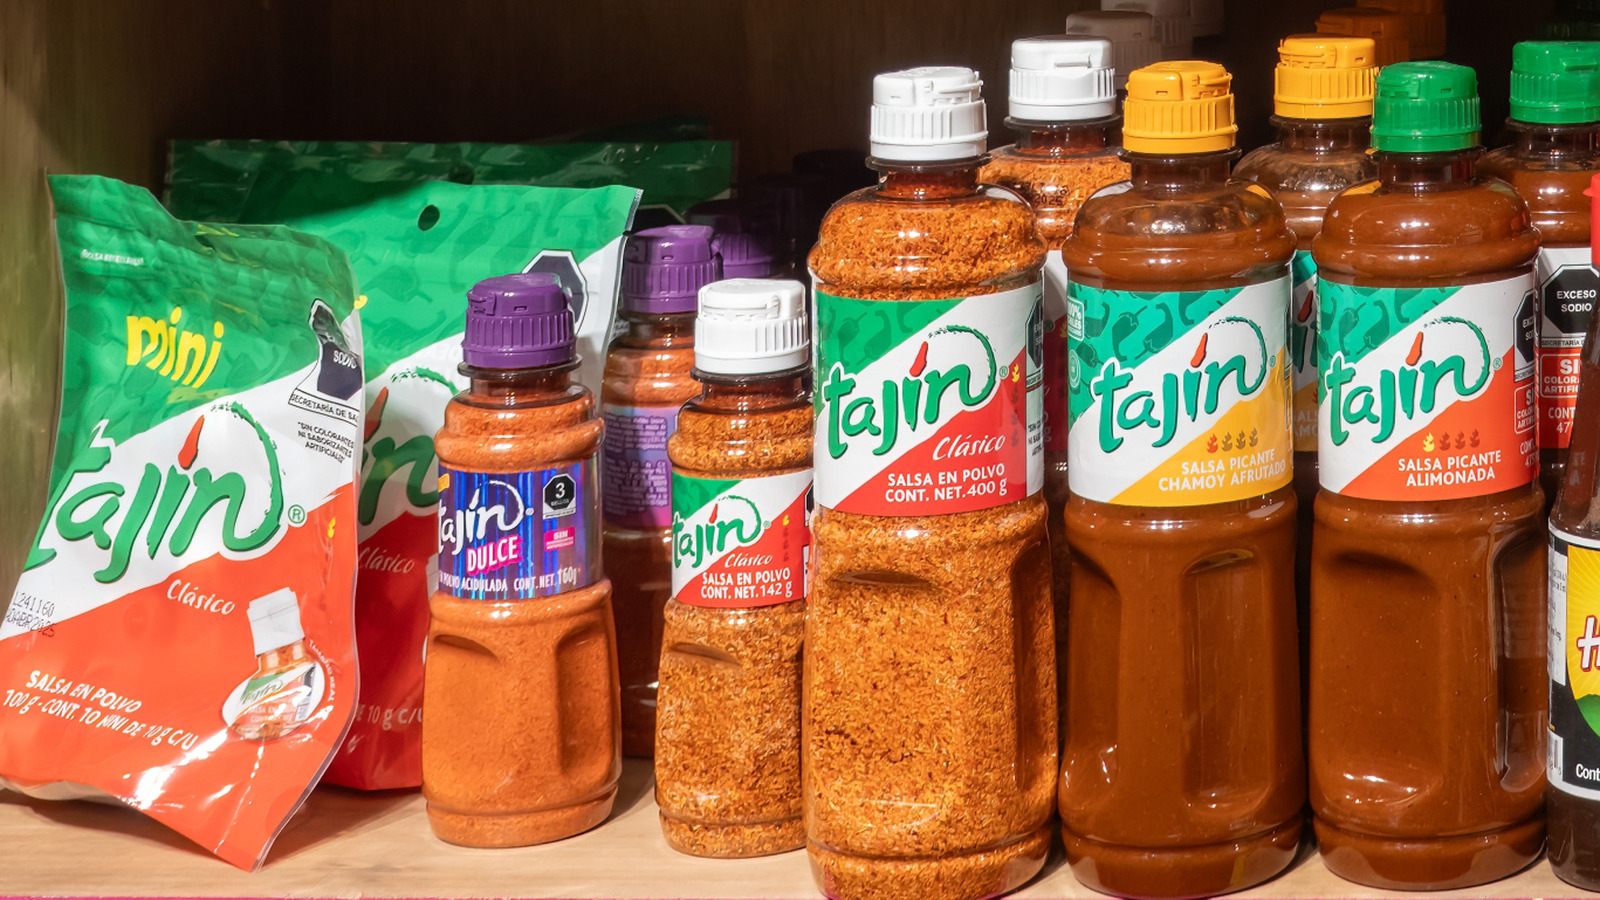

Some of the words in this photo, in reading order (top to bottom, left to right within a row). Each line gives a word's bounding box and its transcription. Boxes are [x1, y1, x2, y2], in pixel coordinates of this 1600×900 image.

[1556, 289, 1597, 299] EXCESO
[1561, 303, 1593, 312] SODIO
[126, 306, 225, 388] mini
[1560, 359, 1579, 375] SI
[932, 434, 1006, 461] Clásico
[1181, 460, 1225, 475] SALSA
[1230, 449, 1275, 470] PICANTE
[1398, 457, 1443, 472] SALSA
[1447, 450, 1502, 470] PICANTE
[888, 472, 933, 487] SALSA
[938, 471, 958, 484] EN
[962, 463, 1005, 482] POLVO
[1158, 475, 1226, 492] CHAMOY
[1230, 461, 1286, 485] AFRUTADO
[1406, 466, 1496, 487] ALIMONADA
[555, 482, 566, 499] 3
[885, 489, 930, 502] CONT.
[999, 477, 1008, 496] g
[467, 535, 519, 573] DULCE
[724, 553, 774, 568] Clásico
[461, 577, 509, 592] ACIDULADA
[702, 571, 734, 586] SALSA
[737, 572, 752, 585] EN
[755, 567, 791, 584] POLVO
[167, 578, 235, 615] Clásico
[701, 585, 732, 599] CONT.
[785, 581, 793, 598] g
[26, 670, 72, 695] SALSA
[70, 683, 95, 700] EN
[90, 688, 143, 713] POLVO
[3, 689, 28, 708] 100
[19, 695, 41, 714] g
[41, 698, 81, 720] CONT.
[79, 707, 101, 725] 10
[96, 714, 129, 731] MINI
[123, 721, 146, 737] DE
[143, 724, 159, 739] 10
[151, 727, 173, 746] g
[167, 729, 199, 750] C/U
